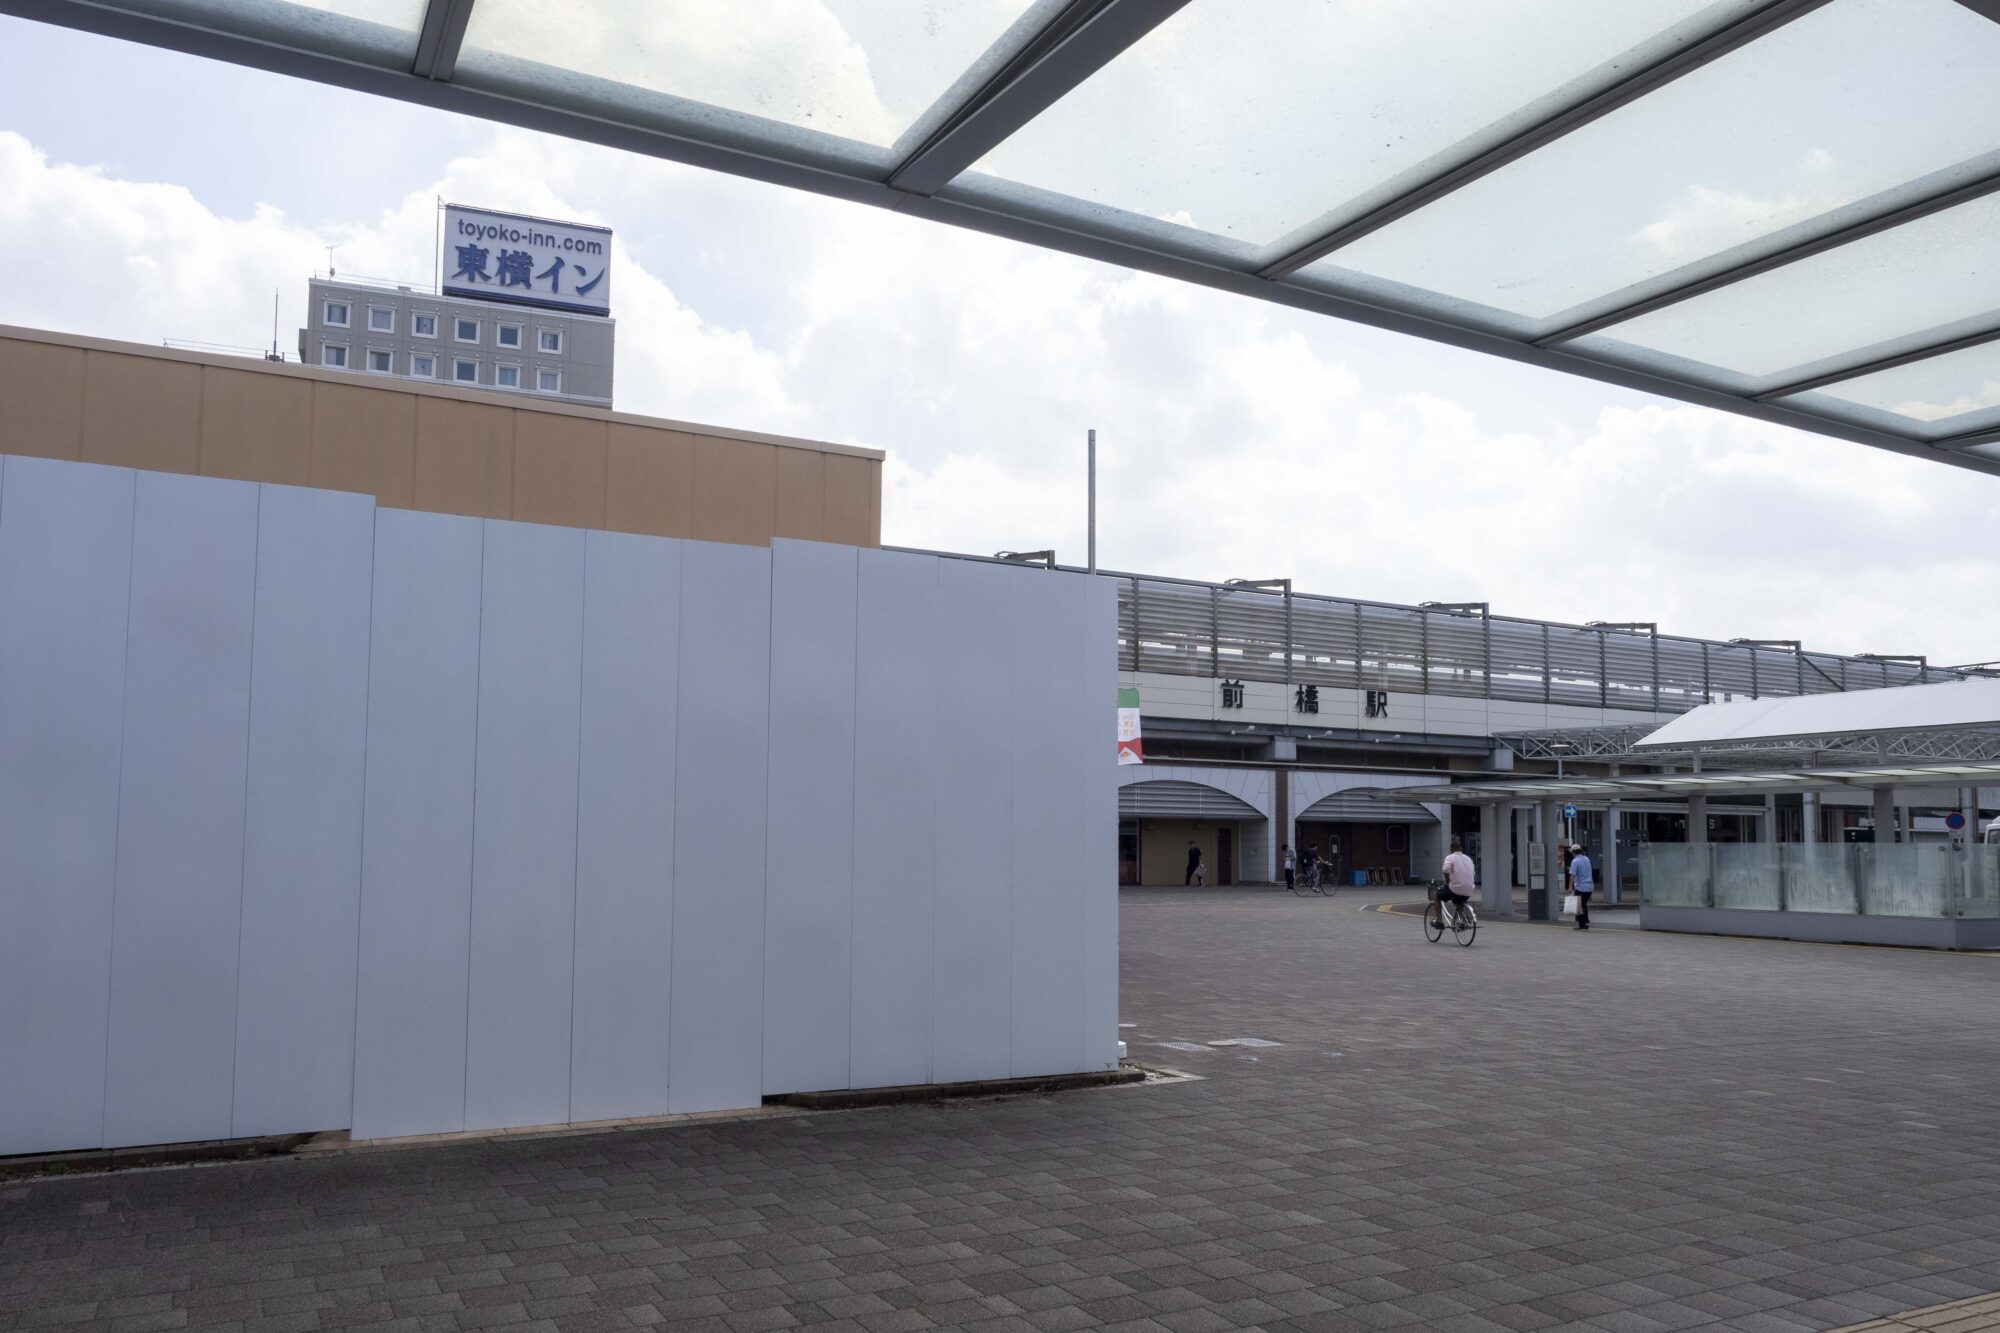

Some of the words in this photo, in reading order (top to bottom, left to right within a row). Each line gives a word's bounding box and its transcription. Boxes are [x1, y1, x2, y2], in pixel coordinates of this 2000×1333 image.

[458, 218, 602, 255] toyoko-inn.com
[452, 243, 605, 296] 東横イン
[1220, 678, 1389, 718] 前橋駅
